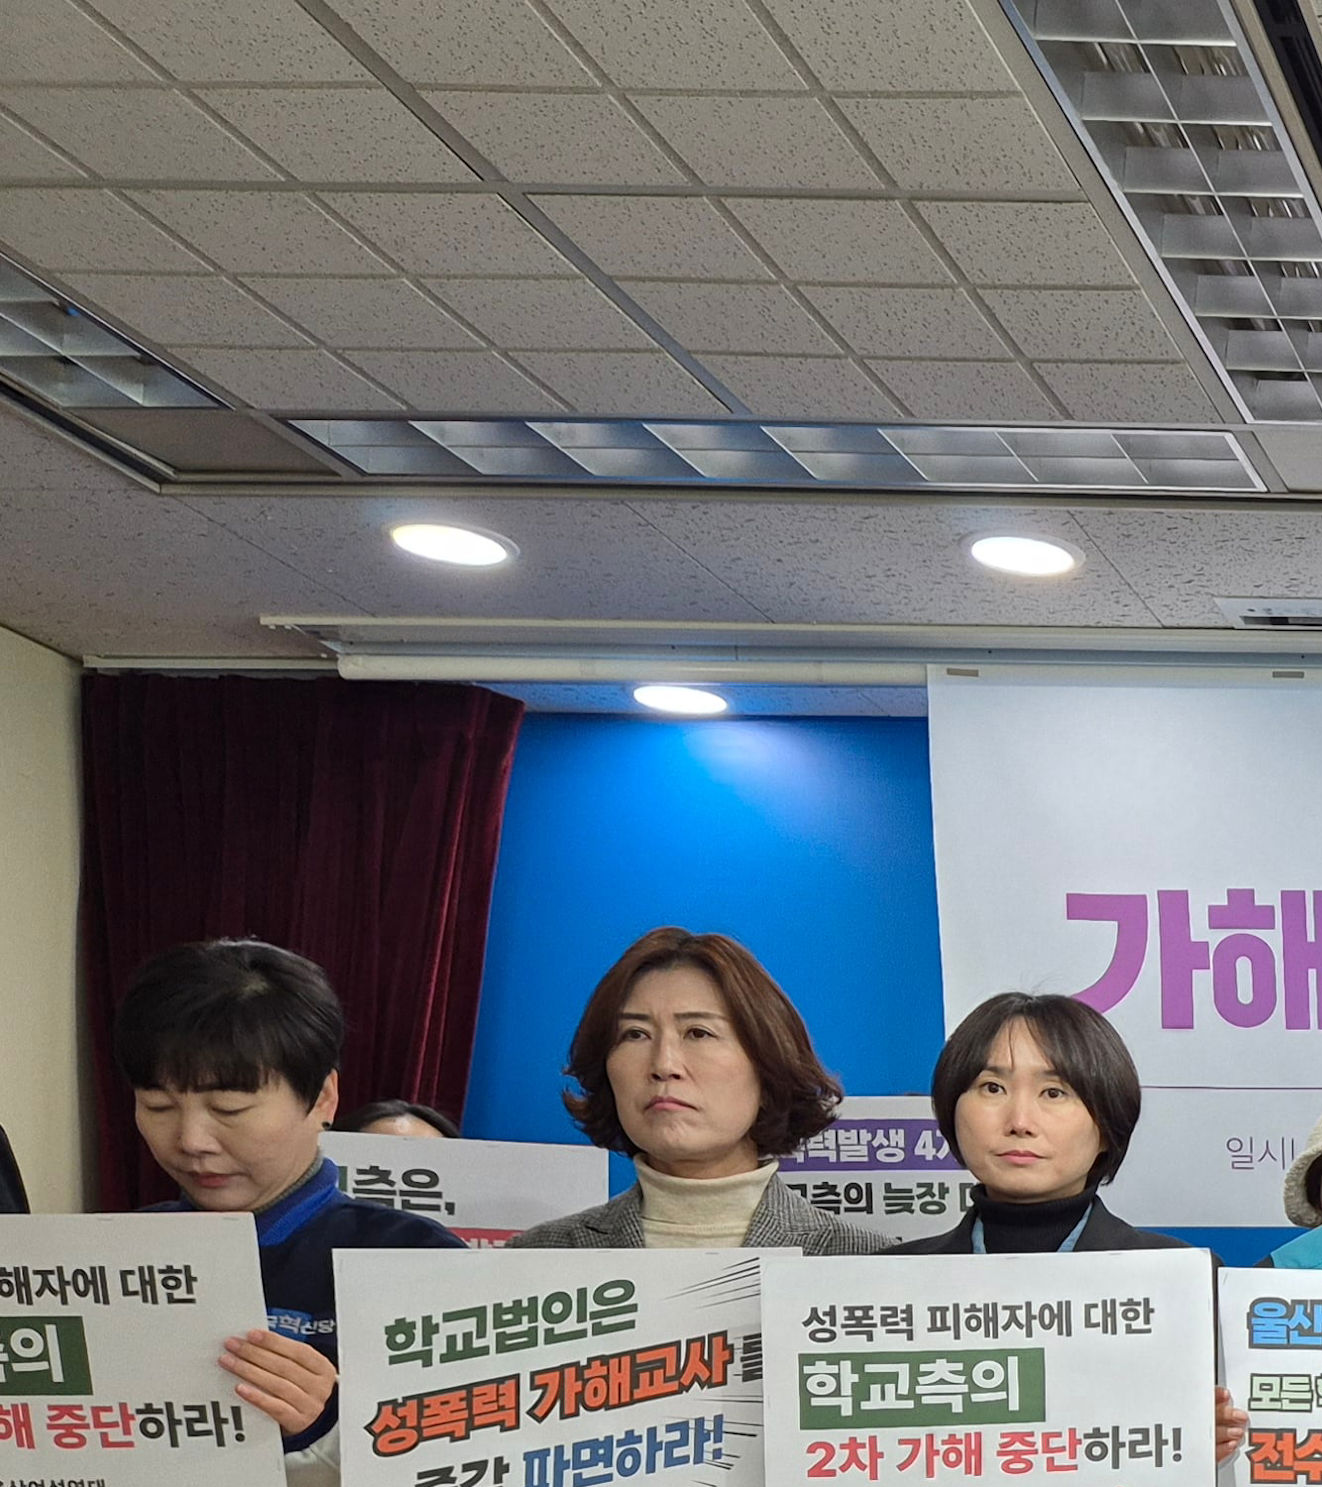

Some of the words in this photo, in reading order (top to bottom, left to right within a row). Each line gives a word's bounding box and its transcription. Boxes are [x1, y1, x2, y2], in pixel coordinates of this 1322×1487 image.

[119, 1265, 198, 1305] 대한
[385, 1279, 638, 1368] 학교법인은
[801, 1304, 914, 1343] 성폭력
[926, 1300, 1072, 1340] 피해자에
[1084, 1298, 1155, 1335] 대한
[364, 1373, 521, 1457] 성폭력
[526, 1330, 735, 1422] 가해교사
[802, 1355, 1020, 1416] 학교측의
[1248, 1374, 1312, 1412] 모든
[46, 1401, 245, 1448] 중단하라!
[806, 1435, 884, 1481] 2차
[896, 1431, 982, 1478] 가해
[996, 1423, 1182, 1475] 중단하라!
